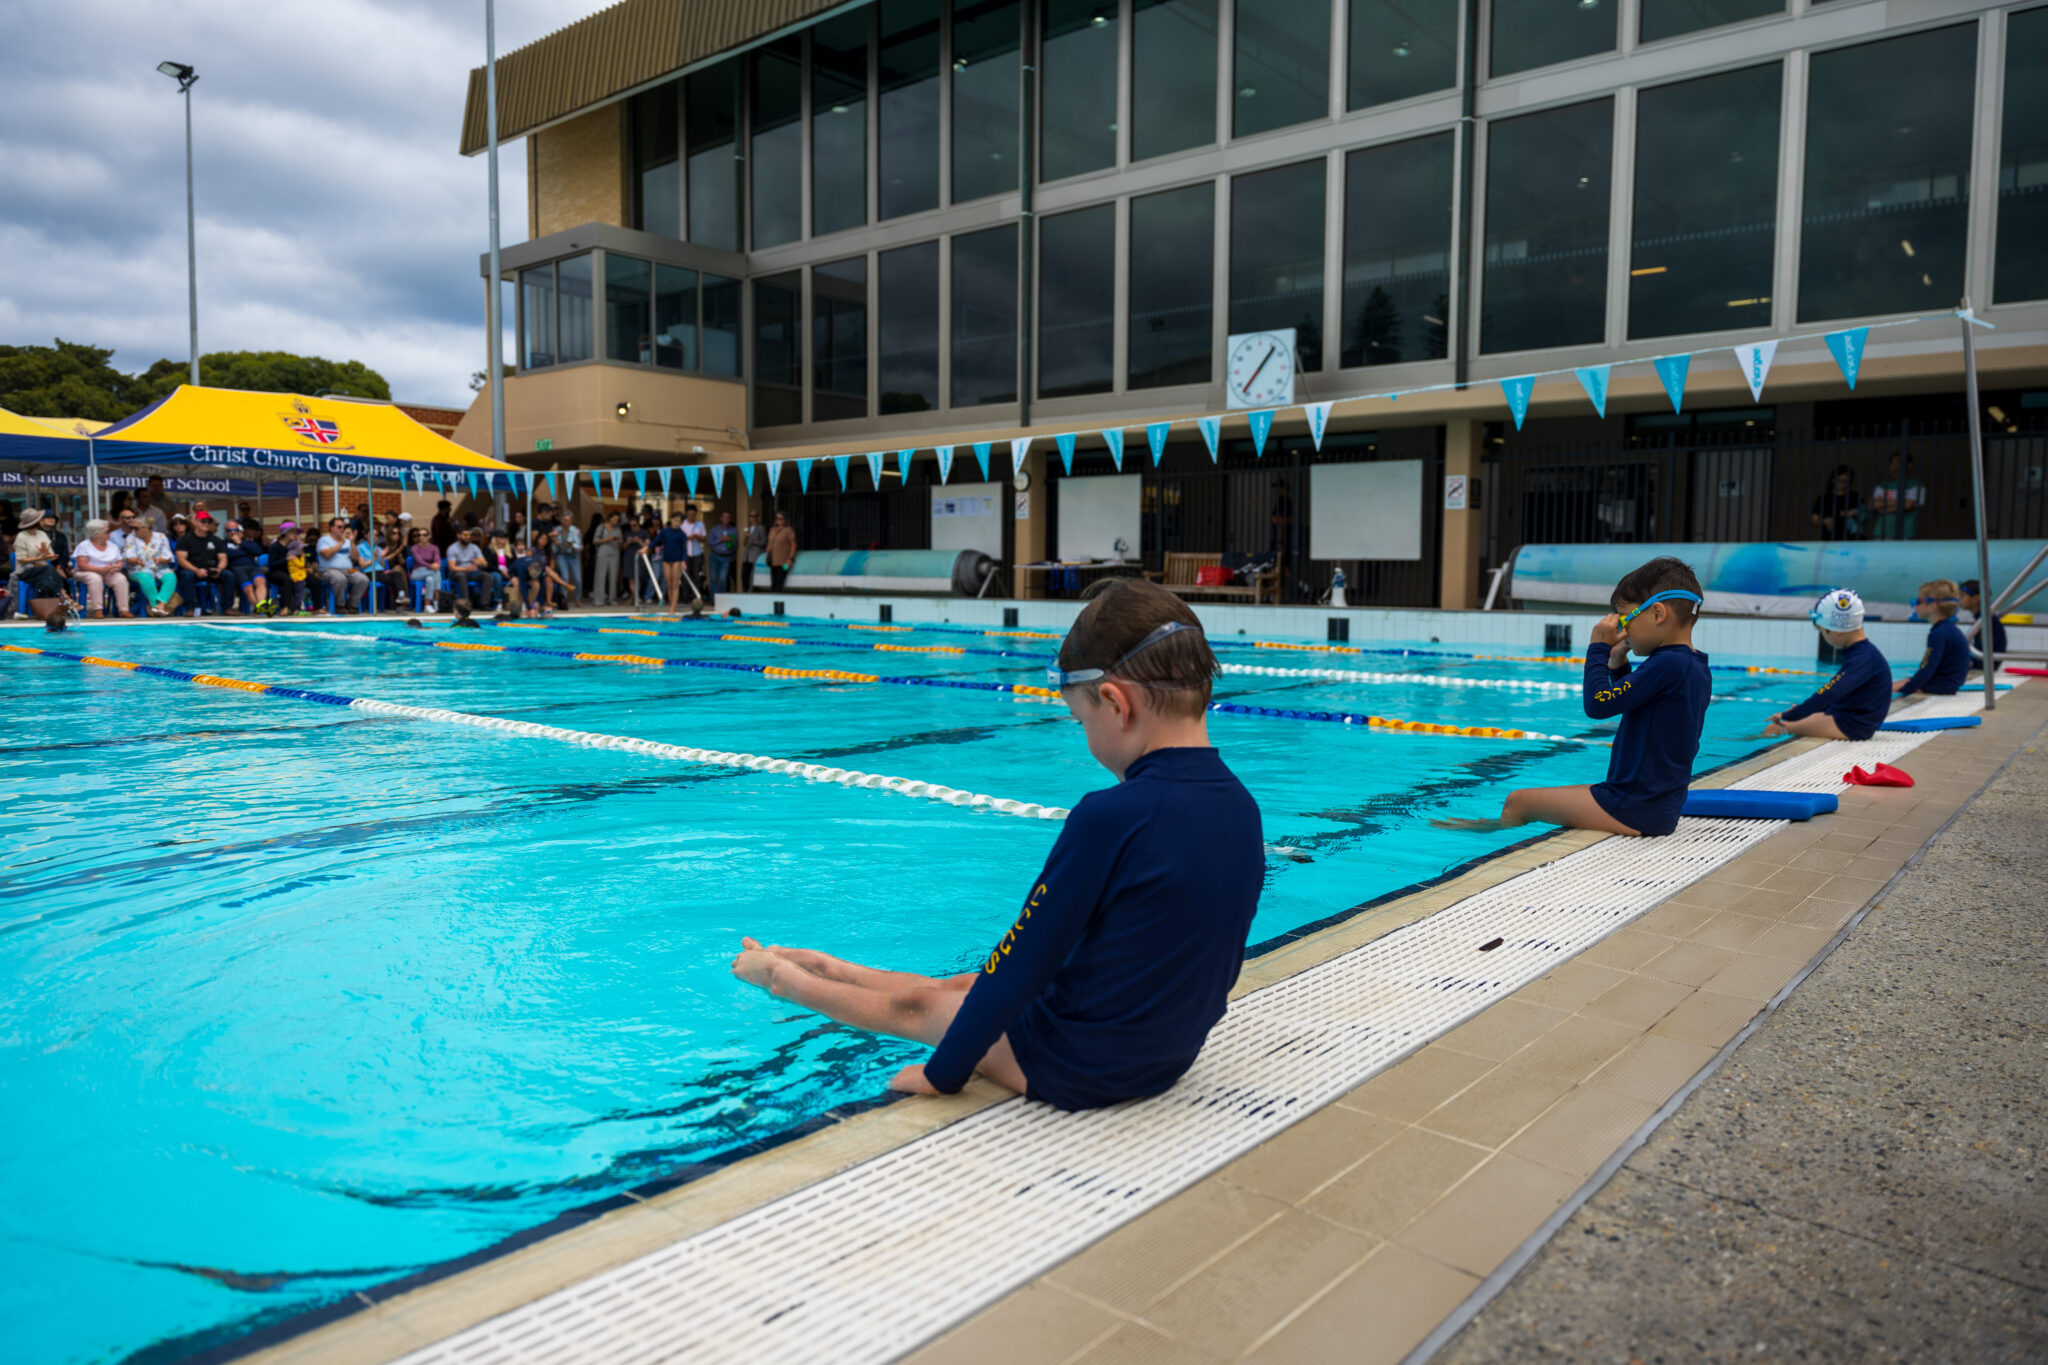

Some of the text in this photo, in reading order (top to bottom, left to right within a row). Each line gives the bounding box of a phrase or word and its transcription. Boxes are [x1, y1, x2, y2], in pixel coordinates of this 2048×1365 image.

[189, 445, 249, 464] Christ
[253, 448, 321, 471] Church
[176, 478, 230, 492] School
[984, 883, 1047, 975] CCGS
